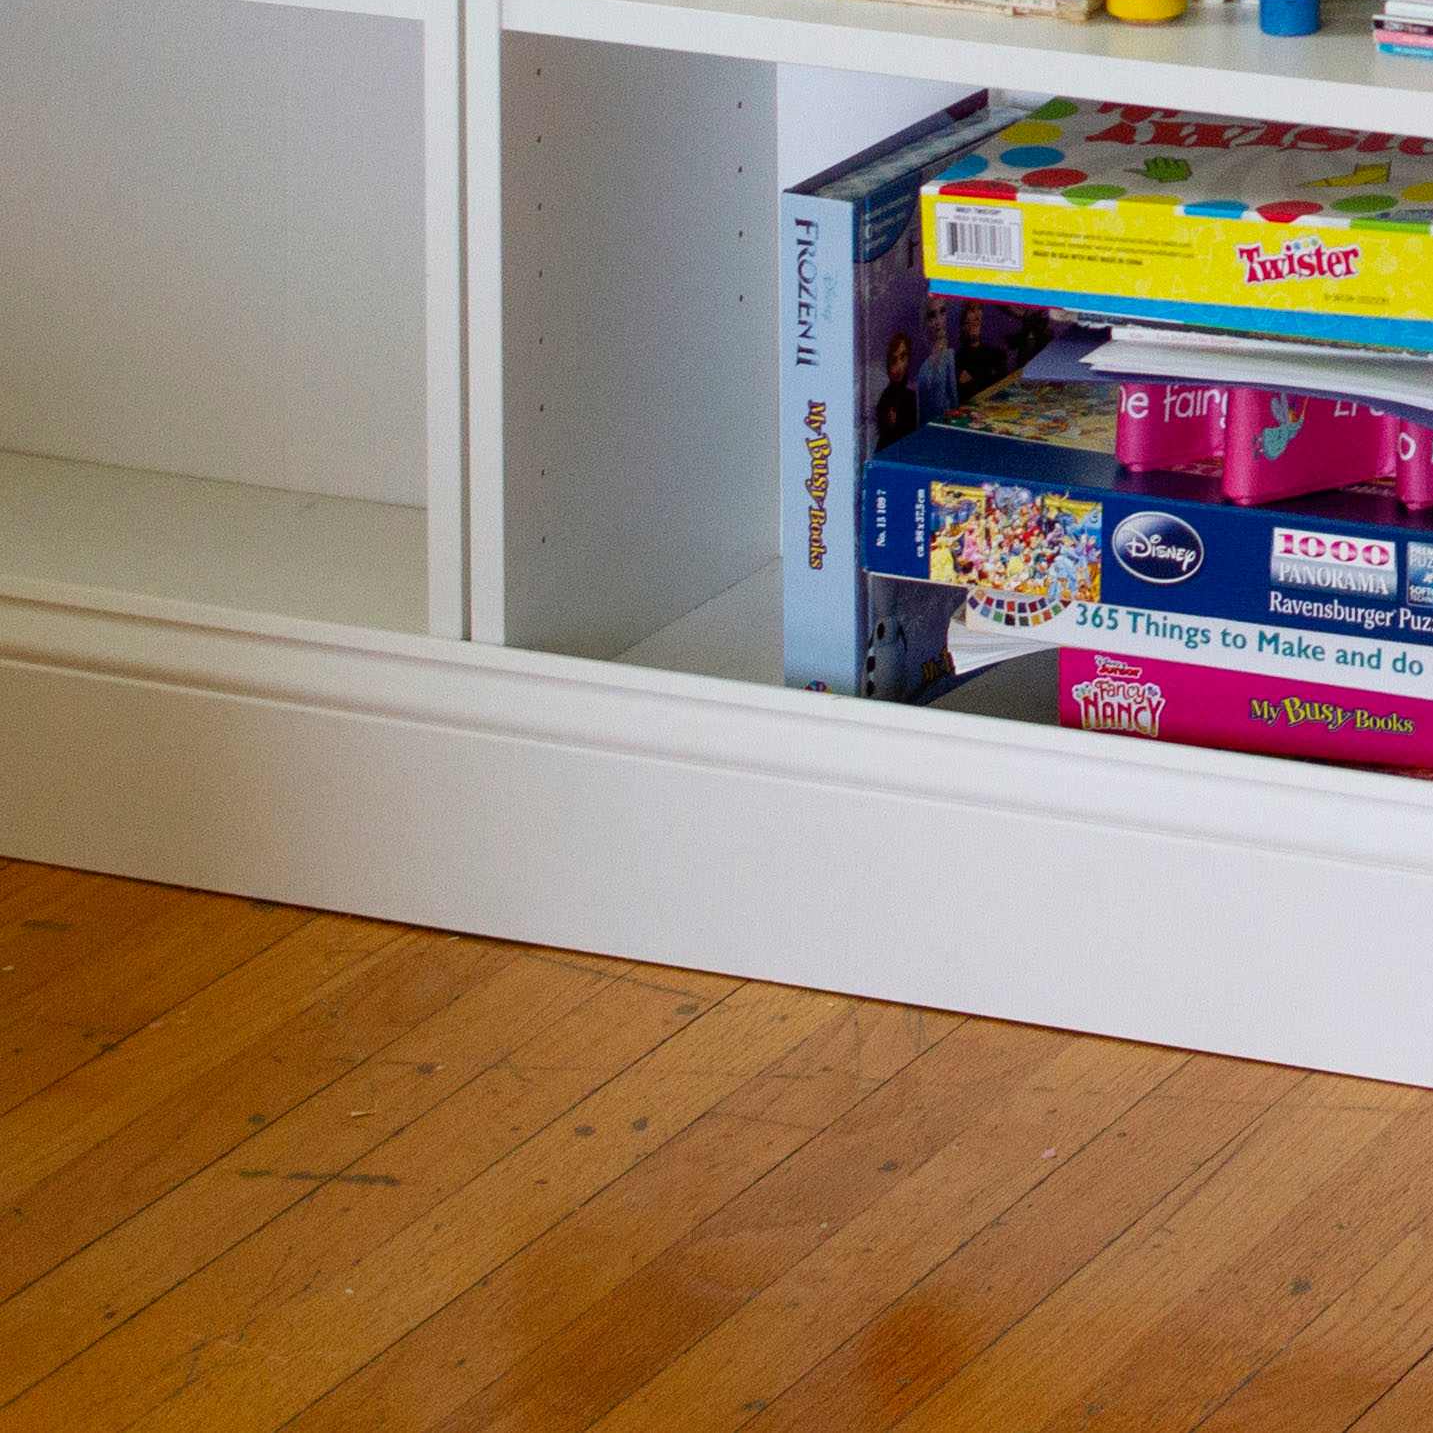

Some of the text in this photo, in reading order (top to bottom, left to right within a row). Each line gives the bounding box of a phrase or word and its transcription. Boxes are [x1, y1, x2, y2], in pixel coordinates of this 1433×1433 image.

[1238, 241, 1361, 285] Twister
[795, 217, 820, 367] FROZEN II
[1276, 534, 1389, 567] 1000
[1277, 564, 1390, 597] PANORAMA
[1269, 592, 1398, 629] Ravensburger
[1075, 603, 1425, 677] 365 Things to Make and do
[1094, 678, 1148, 706] Fancy
[1080, 692, 1164, 738] NANCY
